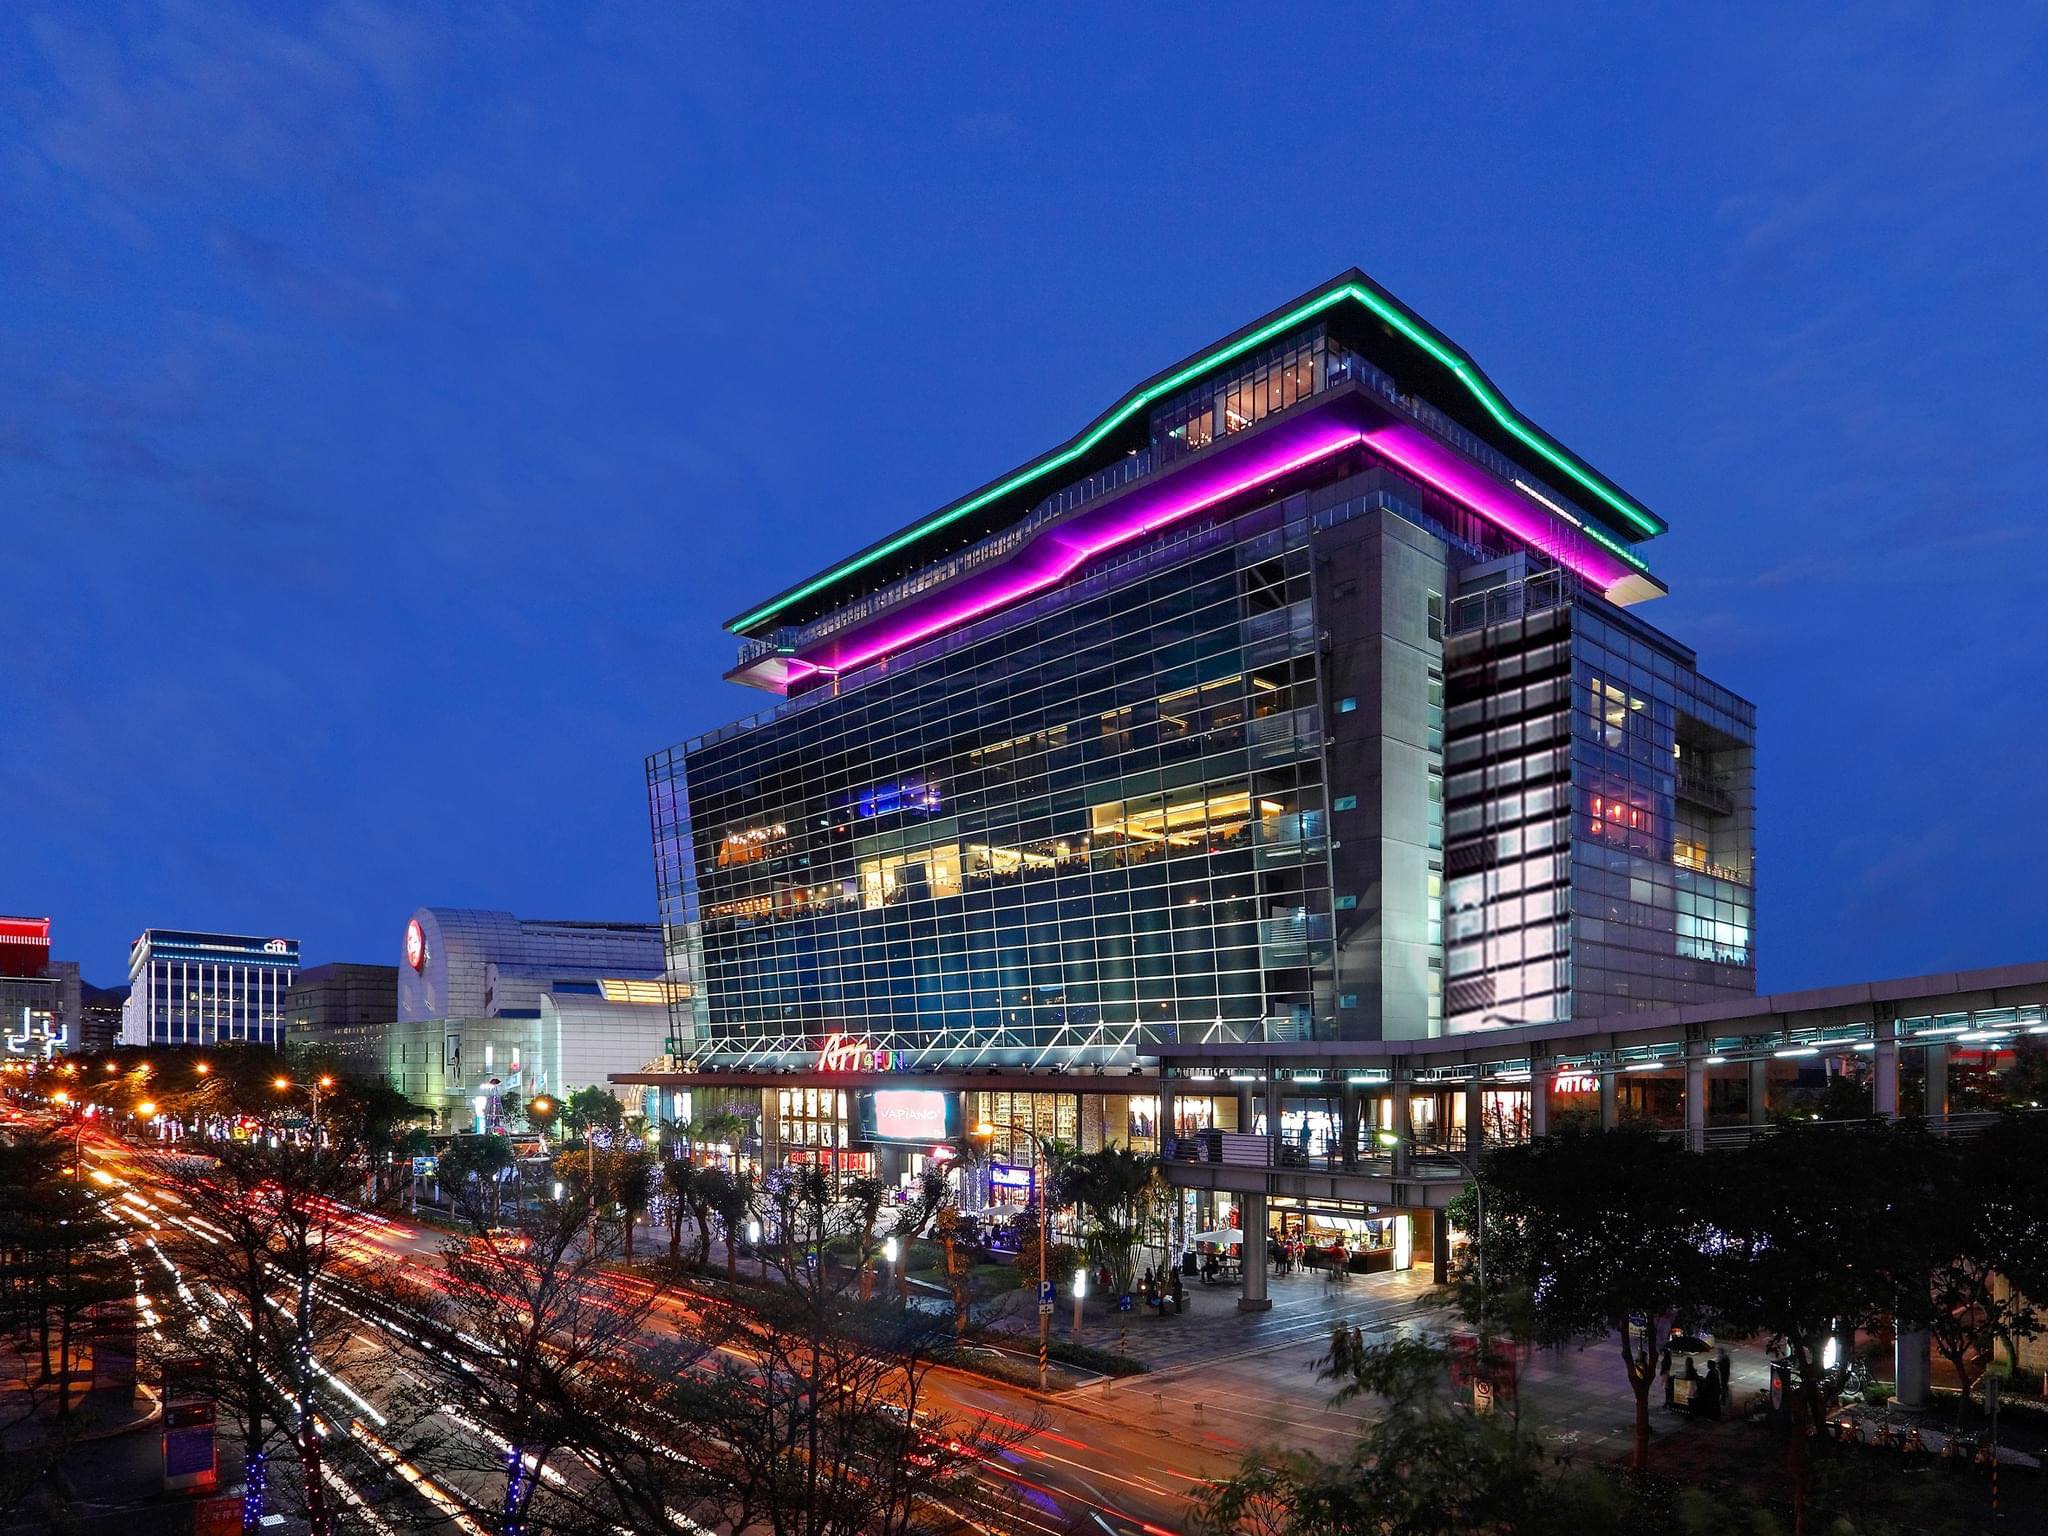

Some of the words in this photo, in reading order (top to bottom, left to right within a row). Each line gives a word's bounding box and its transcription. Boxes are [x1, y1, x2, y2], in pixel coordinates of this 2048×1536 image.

[264, 940, 287, 953] citi
[881, 1107, 937, 1120] VAPIANO
[1041, 1281, 1051, 1297] P
